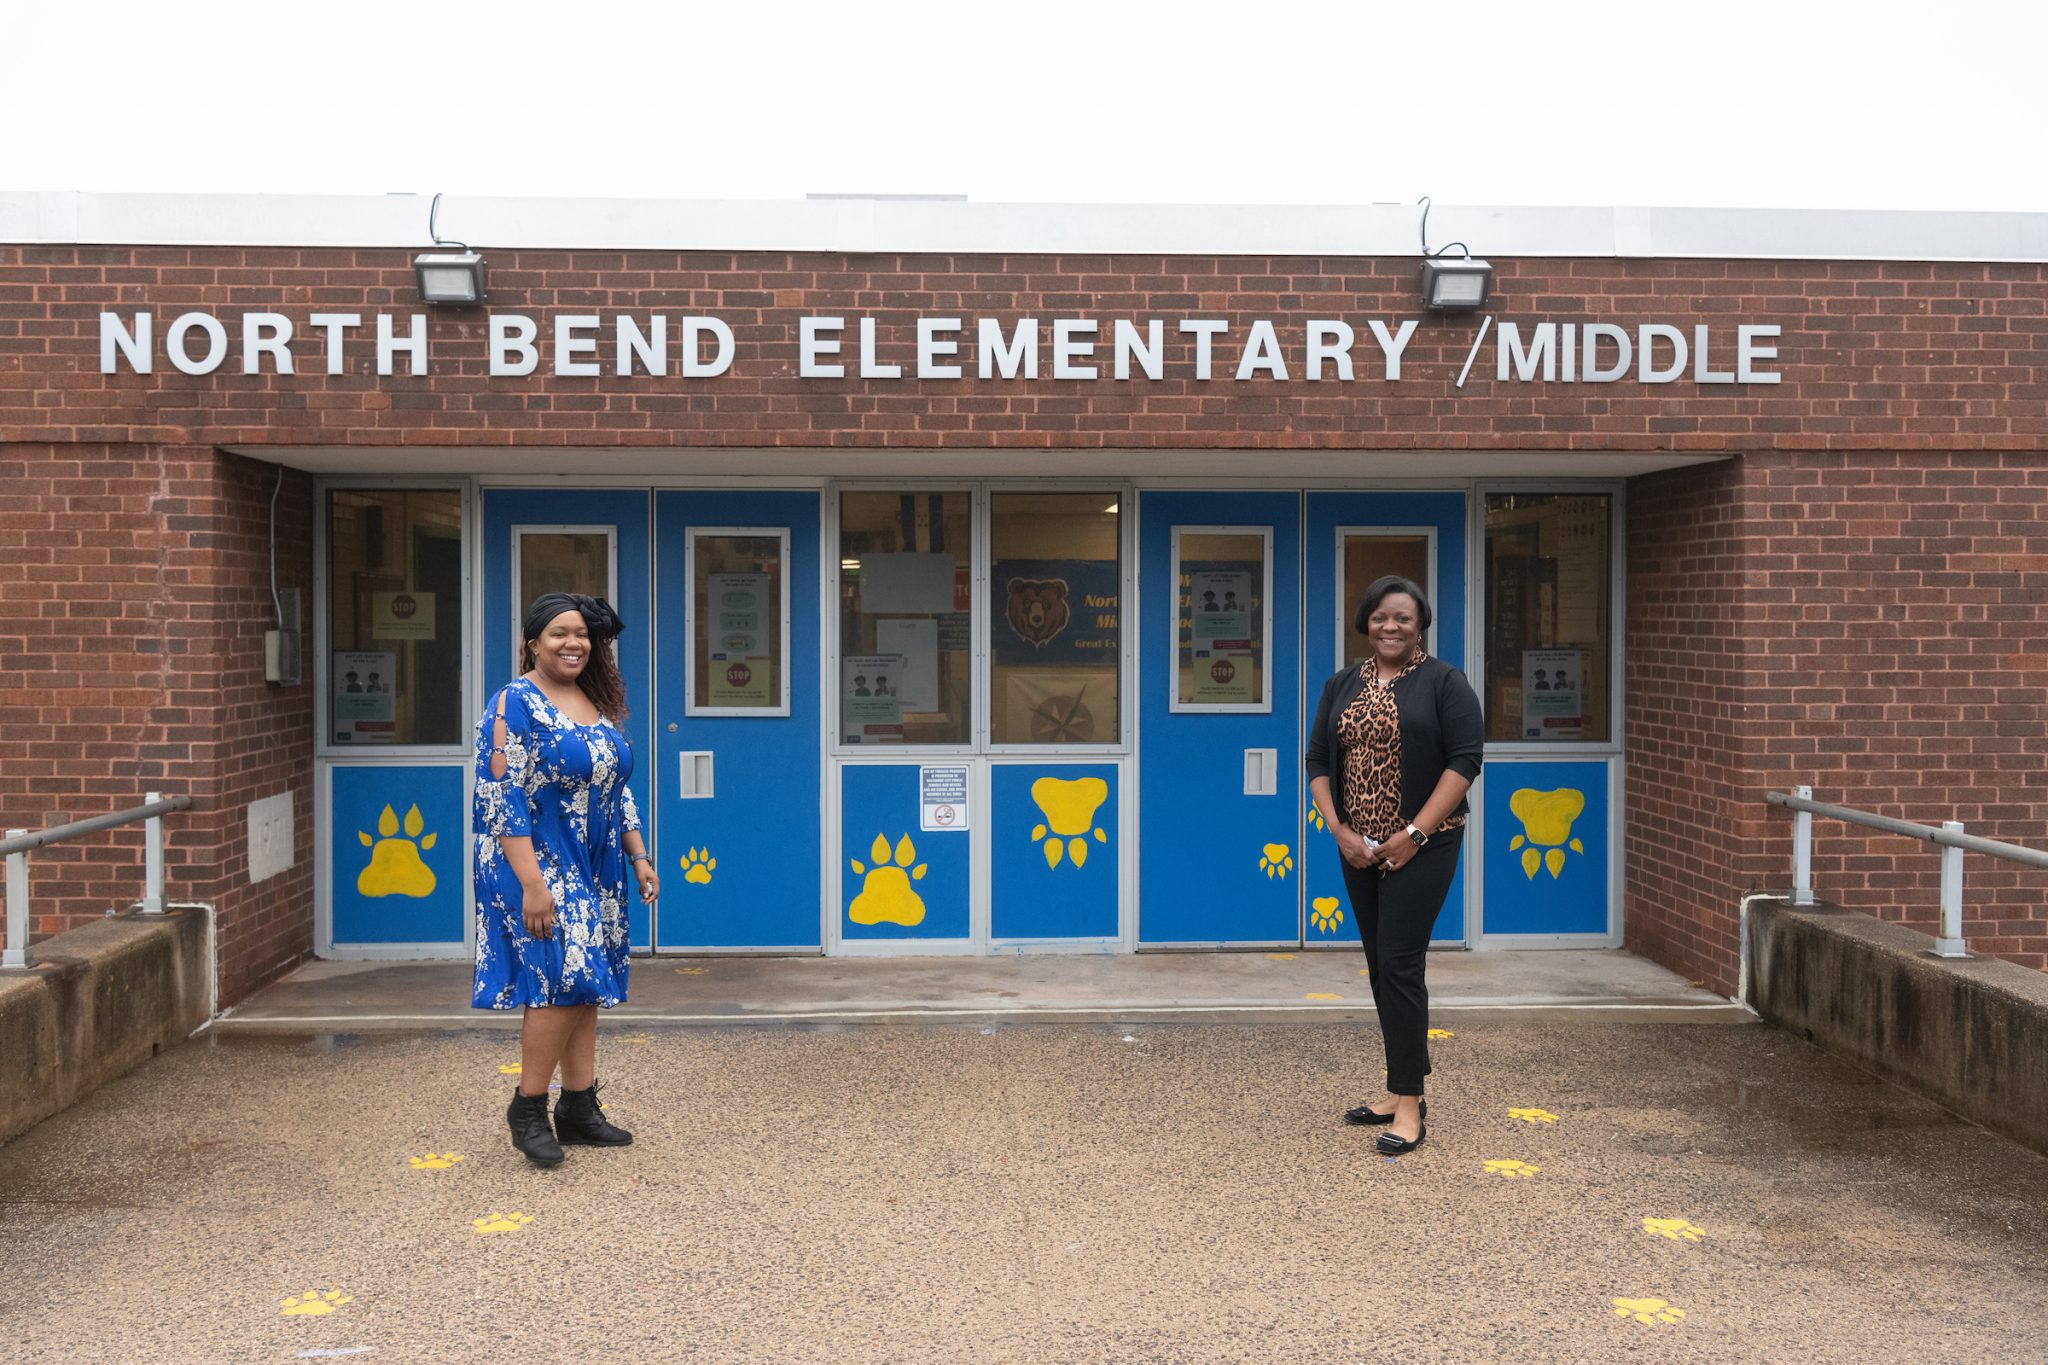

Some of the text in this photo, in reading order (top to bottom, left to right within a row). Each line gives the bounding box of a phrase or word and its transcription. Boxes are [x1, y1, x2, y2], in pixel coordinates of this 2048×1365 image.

[100, 311, 428, 376] NORTH
[489, 314, 735, 378] BEND
[799, 316, 1419, 381] ELEMENTARY
[393, 602, 415, 613] STOP
[727, 670, 750, 681] STOP
[1212, 667, 1234, 677] STOP
